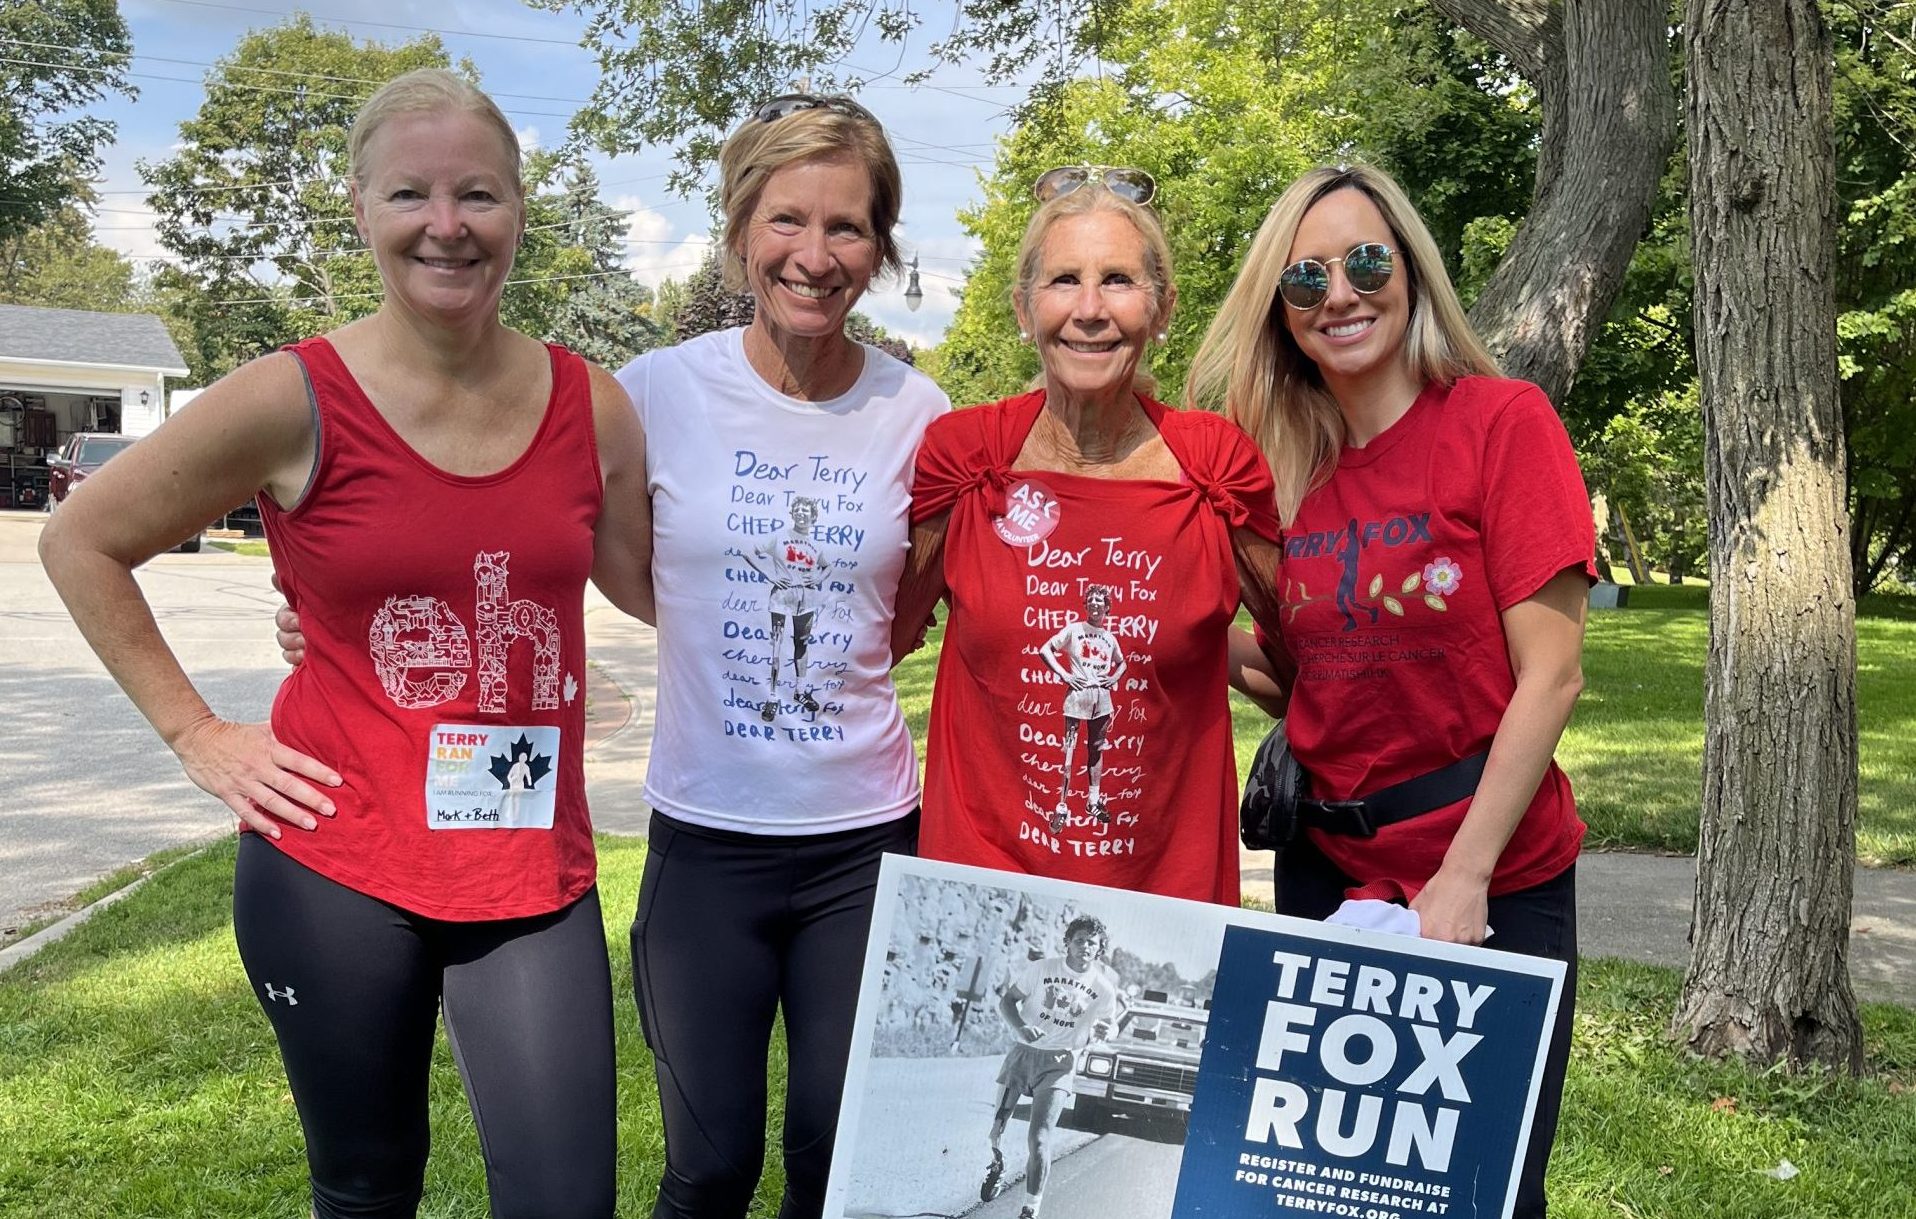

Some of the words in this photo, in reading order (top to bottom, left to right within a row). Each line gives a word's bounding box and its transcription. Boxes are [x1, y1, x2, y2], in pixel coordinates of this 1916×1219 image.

[735, 450, 798, 481] Dear
[808, 455, 868, 494] Terry
[731, 485, 775, 506] Dear
[837, 494, 864, 512] Fox
[1006, 504, 1040, 532] ME
[1362, 512, 1433, 549] FOX
[811, 525, 865, 551] ERRY
[1027, 540, 1092, 568] Dear
[1101, 537, 1162, 581] Terry
[1026, 575, 1069, 596] Dear
[1130, 580, 1157, 601] Fox
[722, 592, 761, 613] dear
[1103, 614, 1158, 645] ERRY
[1339, 634, 1400, 648] RESEARCH
[1372, 650, 1386, 662] LE
[1389, 647, 1446, 661] CANCER
[722, 671, 760, 685] dear
[1017, 692, 1058, 716] dear
[437, 732, 489, 747] TERRY
[781, 725, 844, 742] TERRY
[437, 747, 473, 760] RAN
[447, 790, 478, 798] RUNNING
[472, 807, 500, 821] Beth
[1066, 837, 1135, 857] TERRY
[1043, 976, 1099, 1000] MARATHON
[1273, 950, 1497, 1029] TERRY
[1040, 1011, 1051, 1021] OF
[1053, 1018, 1075, 1029] HOPE
[1255, 1000, 1485, 1104] FOX
[1244, 1076, 1461, 1174] RUN
[1239, 1152, 1317, 1176] REGISTER
[1320, 1166, 1356, 1183] AND
[1360, 1172, 1451, 1199] FUNDRAISE
[1235, 1169, 1268, 1187] FOR
[1272, 1176, 1336, 1198] CANCER
[1340, 1187, 1423, 1212] RESEARCH
[1427, 1202, 1449, 1215] AT
[1276, 1193, 1401, 1219] TERRYFOX.ORG
